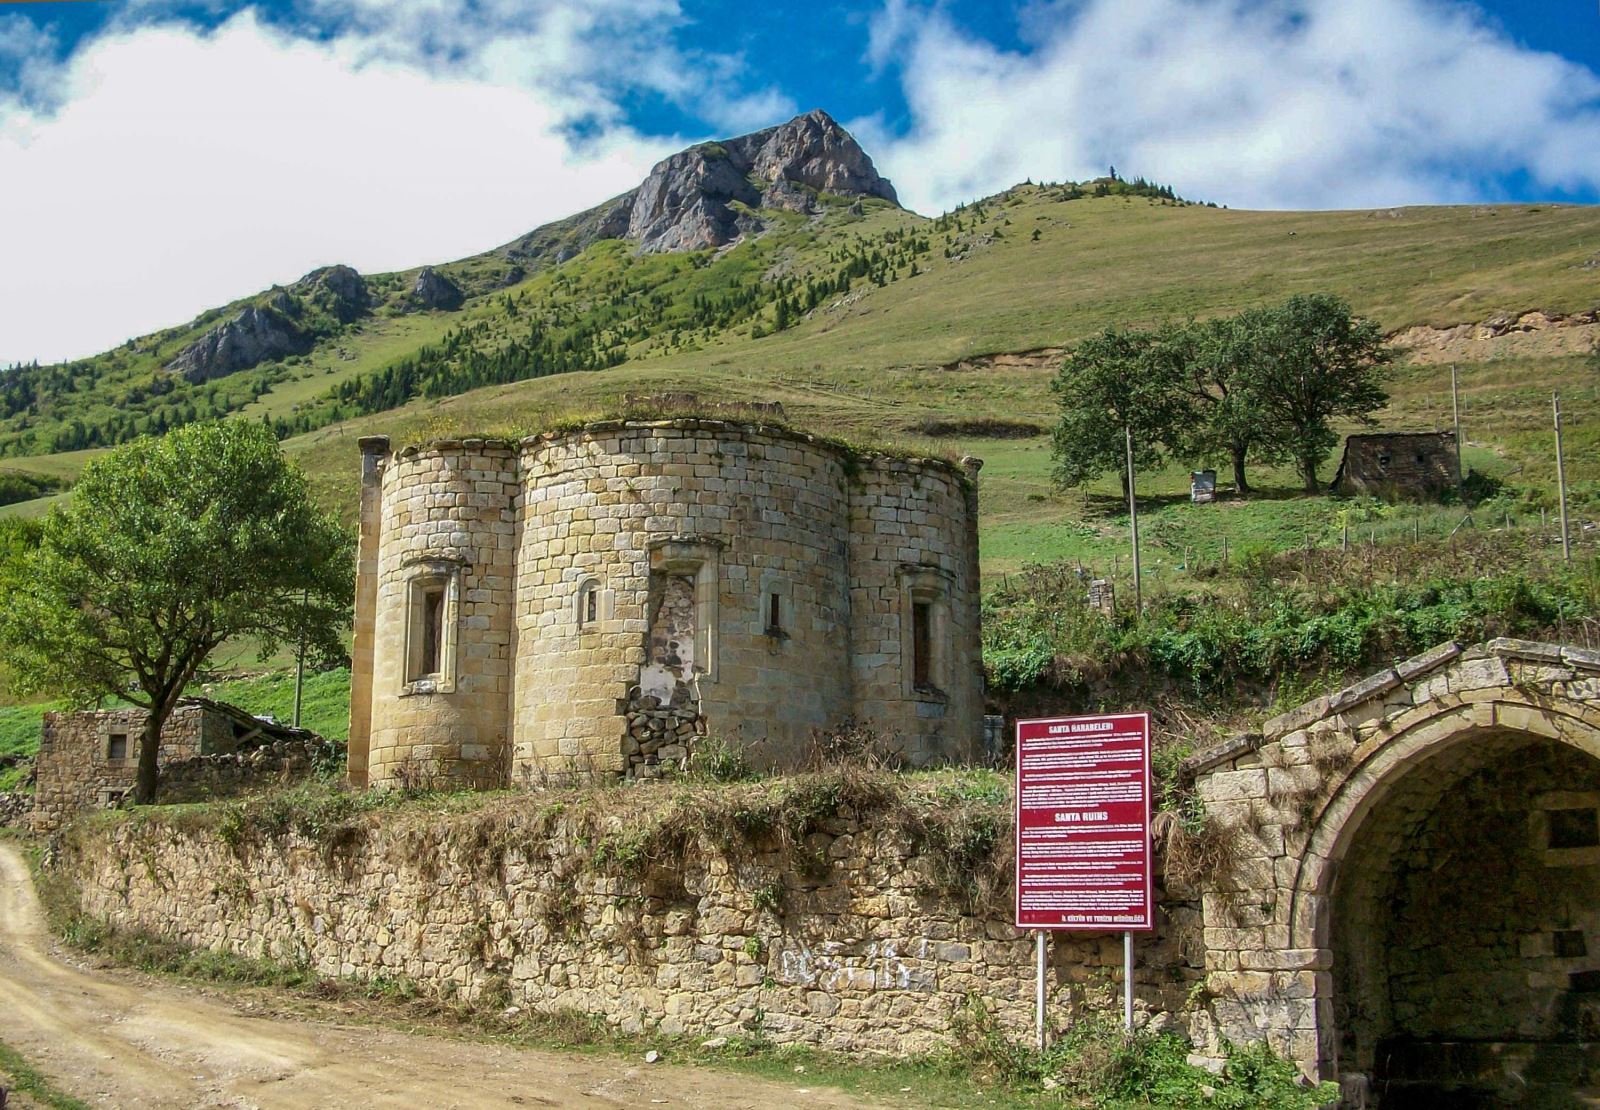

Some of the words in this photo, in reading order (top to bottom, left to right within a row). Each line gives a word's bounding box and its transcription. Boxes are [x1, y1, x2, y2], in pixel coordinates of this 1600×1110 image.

[1048, 725, 1070, 734] SANTA
[1055, 812, 1081, 822] SANTA
[1082, 811, 1108, 821] RUINS
